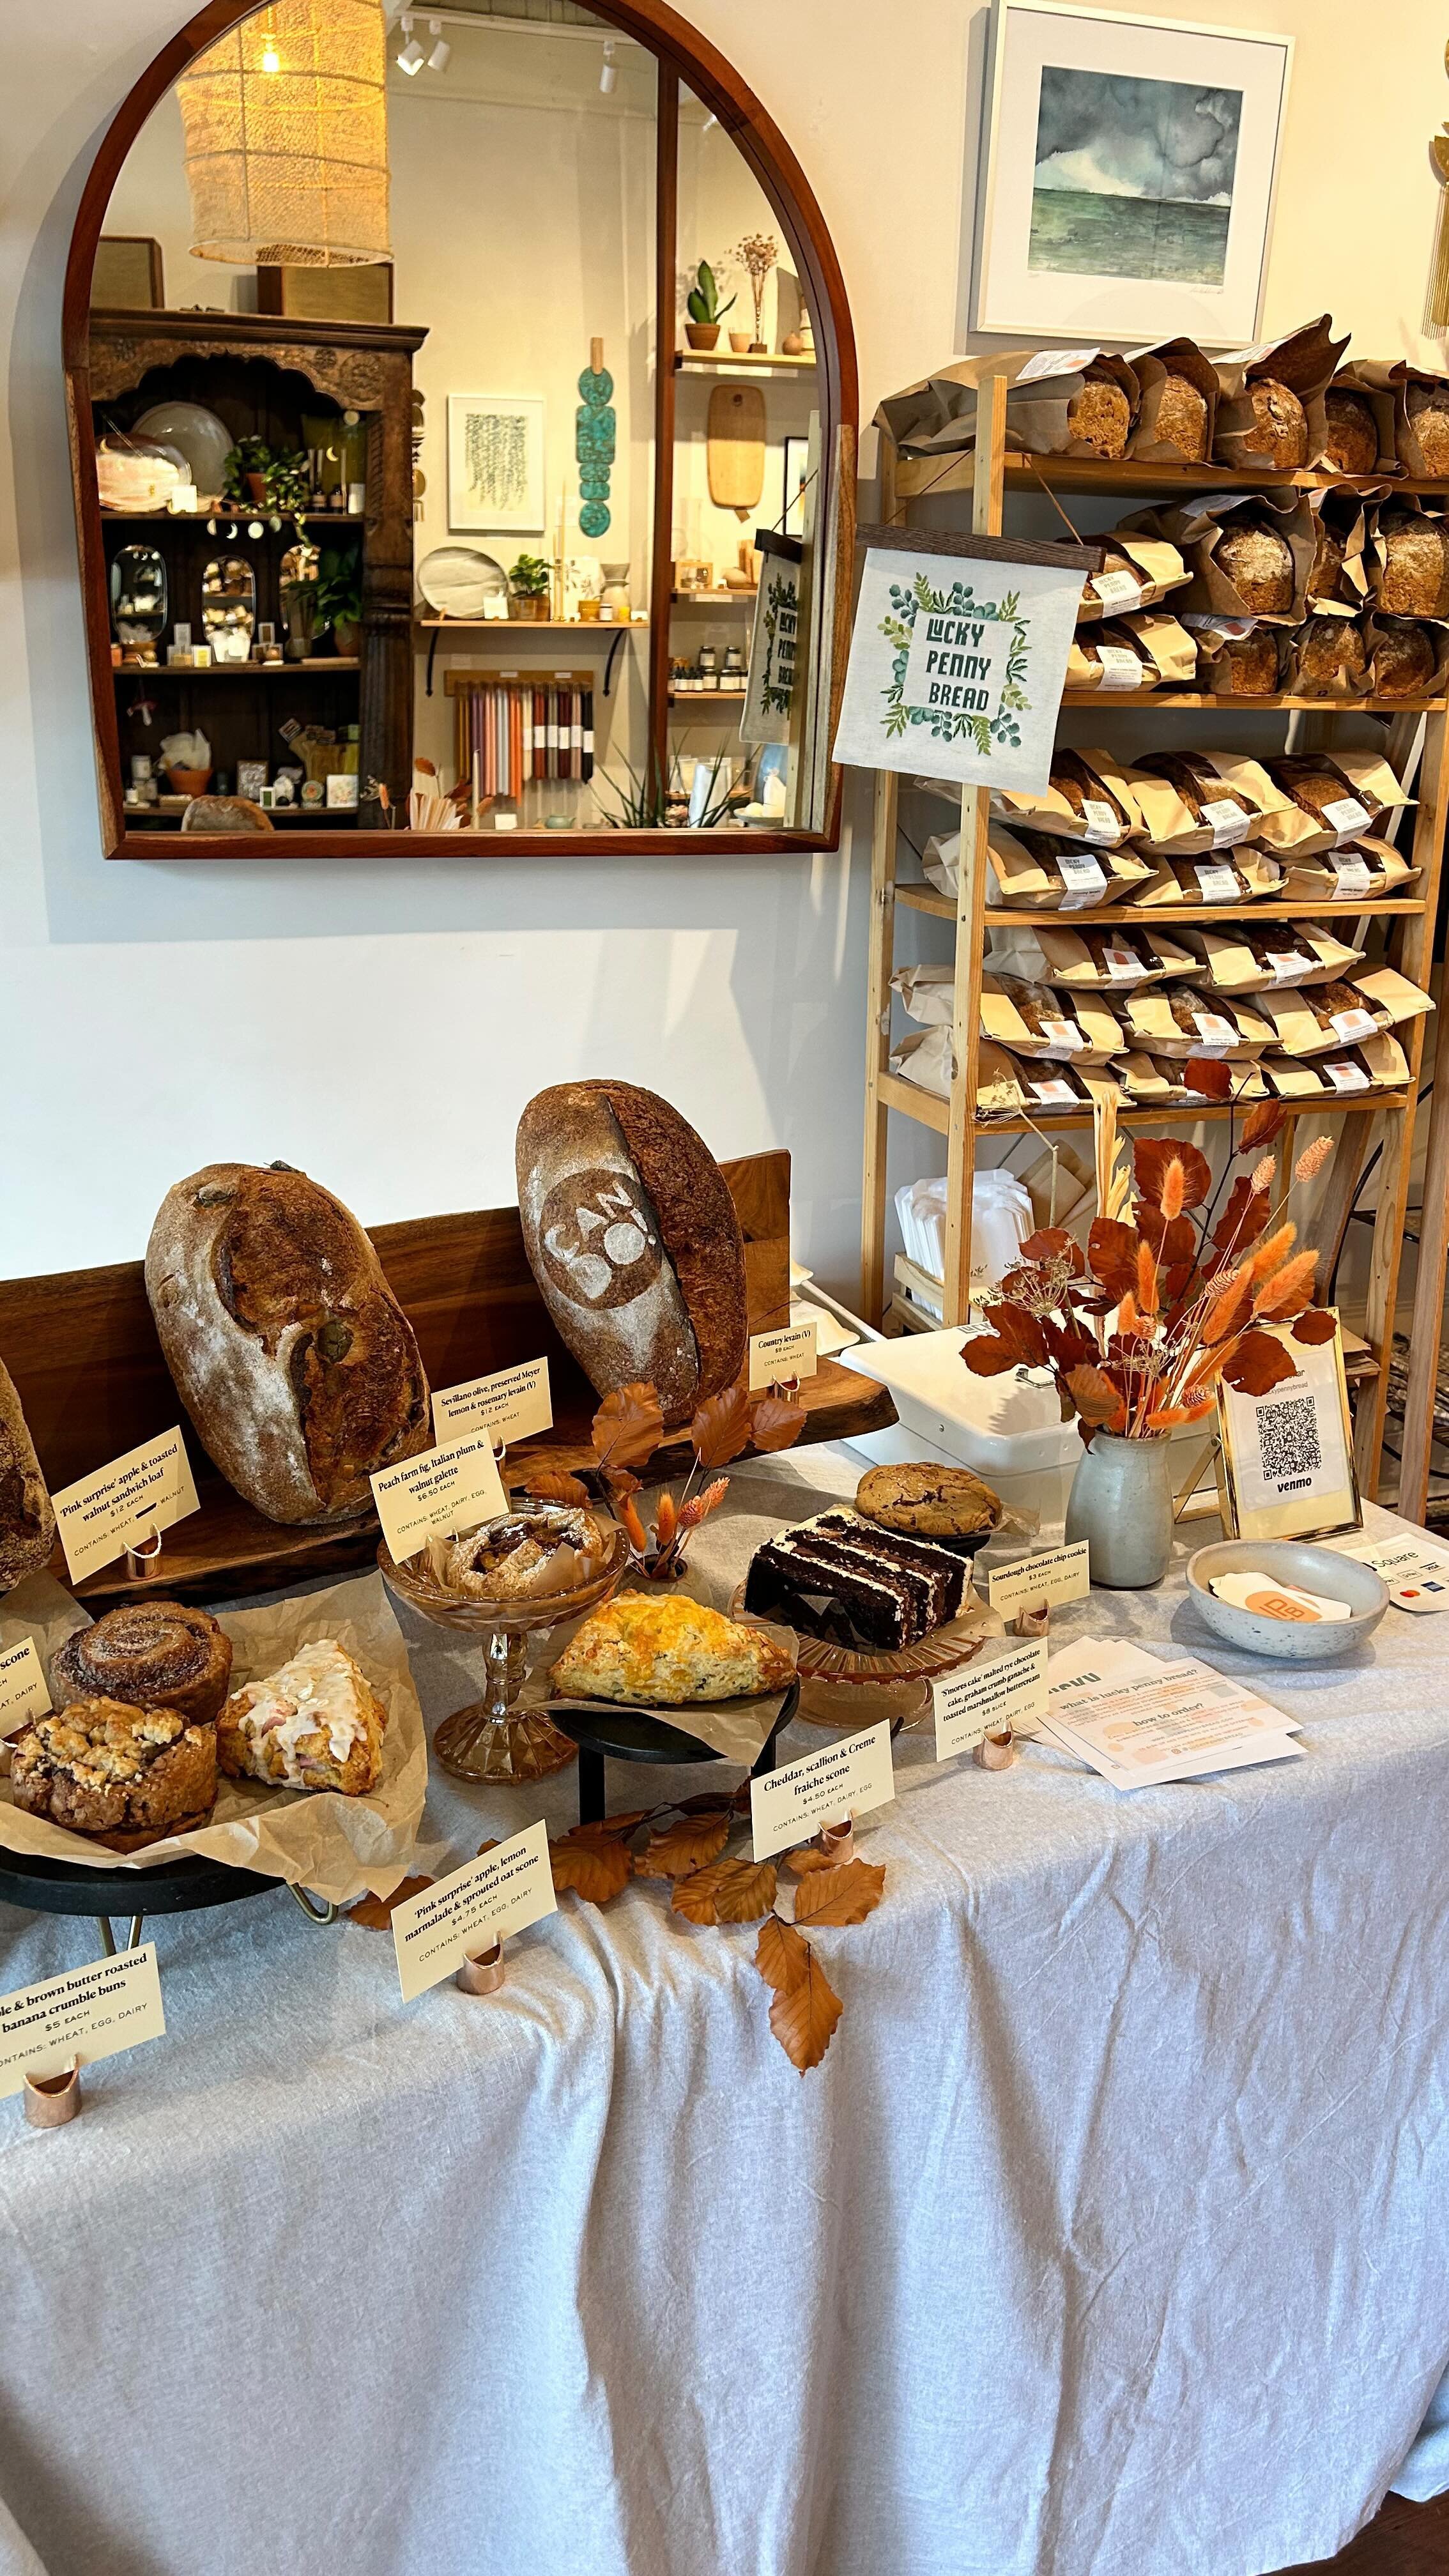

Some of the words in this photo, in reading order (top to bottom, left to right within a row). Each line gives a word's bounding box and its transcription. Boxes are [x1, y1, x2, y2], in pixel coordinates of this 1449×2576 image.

[926, 618, 985, 647] LUCKY
[926, 650, 992, 680] PENNY
[928, 682, 990, 711] BREAD
[758, 1337, 783, 1349] Country
[784, 1333, 801, 1343] levain
[801, 1330, 811, 1339] (V)
[441, 1391, 473, 1407] Sevillano
[473, 1386, 490, 1397] olive,
[491, 1374, 522, 1393] preserved
[521, 1367, 540, 1379] Meyer
[448, 1405, 470, 1417] lemon
[470, 1401, 477, 1409] &
[477, 1392, 507, 1408] rosemary
[508, 1386, 526, 1399] levain
[526, 1381, 537, 1391] (V)
[480, 1407, 493, 1416] $12
[494, 1402, 509, 1411] EACH
[502, 1411, 520, 1423] WHEAT
[118, 1467, 140, 1485] apple
[141, 1462, 149, 1472] &
[148, 1443, 178, 1466] toasted
[378, 1475, 401, 1492] Peach
[401, 1468, 418, 1483] farm
[418, 1462, 431, 1475] fig,
[431, 1452, 456, 1468] Italian
[456, 1443, 477, 1460] plum
[477, 1439, 484, 1449] &
[82, 1500, 111, 1522] walnut
[111, 1477, 149, 1506] sandwich
[147, 1466, 165, 1484] loaf
[160, 1485, 185, 1504] WALNUT
[408, 1478, 433, 1495] walnut
[433, 1466, 459, 1486] galette
[417, 1487, 438, 1502] $6.50
[440, 1480, 456, 1492] EACH
[1277, 1476, 1312, 1493] venmo
[110, 1505, 124, 1517] $12
[126, 1494, 144, 1508] EACH
[431, 1510, 454, 1526] WALNUT
[992, 1567, 1025, 1583] Sourdough
[1025, 1558, 1054, 1572] chocolate
[1054, 1553, 1067, 1563] chip
[1067, 1547, 1087, 1559] cookie
[1372, 1551, 1419, 1570] Square
[1064, 1571, 1080, 1581] DAIRY
[0, 1647, 30, 1670] scone
[983, 1664, 1004, 1680] malted
[1004, 1661, 1013, 1671] rye
[1013, 1649, 1041, 1665] chocolate
[15, 1682, 37, 1700] DAIRY
[943, 1706, 967, 1722] toasted
[967, 1689, 1006, 1711] marshmallow
[1006, 1673, 1041, 1694] buttercream
[947, 1696, 964, 1708] cake,
[964, 1686, 987, 1703] graham
[988, 1676, 1007, 1691] crumb
[1007, 1666, 1031, 1683] ganache
[1059, 1698, 1089, 1710] what
[1089, 1694, 1100, 1703] is
[1101, 1687, 1131, 1700] lucky
[1131, 1678, 1164, 1692] penny
[1165, 1668, 1197, 1682] bread?
[992, 1701, 1007, 1712] SLICE
[1023, 1701, 1036, 1711] EGG
[1133, 1717, 1158, 1726] how
[1158, 1712, 1170, 1720] to
[1170, 1702, 1205, 1716] order?
[763, 1768, 804, 1792] Cheddar,
[806, 1752, 839, 1774] scallion
[839, 1748, 847, 1758] &
[848, 1735, 877, 1754] Creme
[794, 1775, 825, 1796] fraiche
[825, 1764, 850, 1781] scone
[802, 1790, 825, 1805] $4.50
[827, 1783, 844, 1795] EACH
[859, 1782, 873, 1793] EGG
[474, 1864, 500, 1883] apple,
[500, 1847, 527, 1867] lemon
[404, 1908, 453, 1943] marmalade
[454, 1901, 461, 1911] &
[462, 1878, 500, 1906] sprouted
[500, 1869, 514, 1882] oat
[514, 1855, 539, 1873] scone
[451, 1906, 477, 1926] $4.75
[479, 1894, 498, 1909] EACH
[419, 1933, 460, 1963] CONTAINS:
[510, 1887, 533, 1905] DAIRY
[14, 2000, 25, 2011] &
[26, 1986, 66, 2007] brown
[66, 1970, 103, 1991] butter
[104, 1952, 148, 1977] roasted
[3, 2011, 47, 2034] banana
[49, 1990, 97, 2015] crumble
[98, 1980, 126, 1997] buns
[45, 2020, 61, 2032] $5
[64, 2009, 91, 2025] EACH
[49, 2027, 89, 2047] WHEAT,
[91, 2018, 116, 2031] EGG,
[118, 2002, 148, 2020] DAIRY
